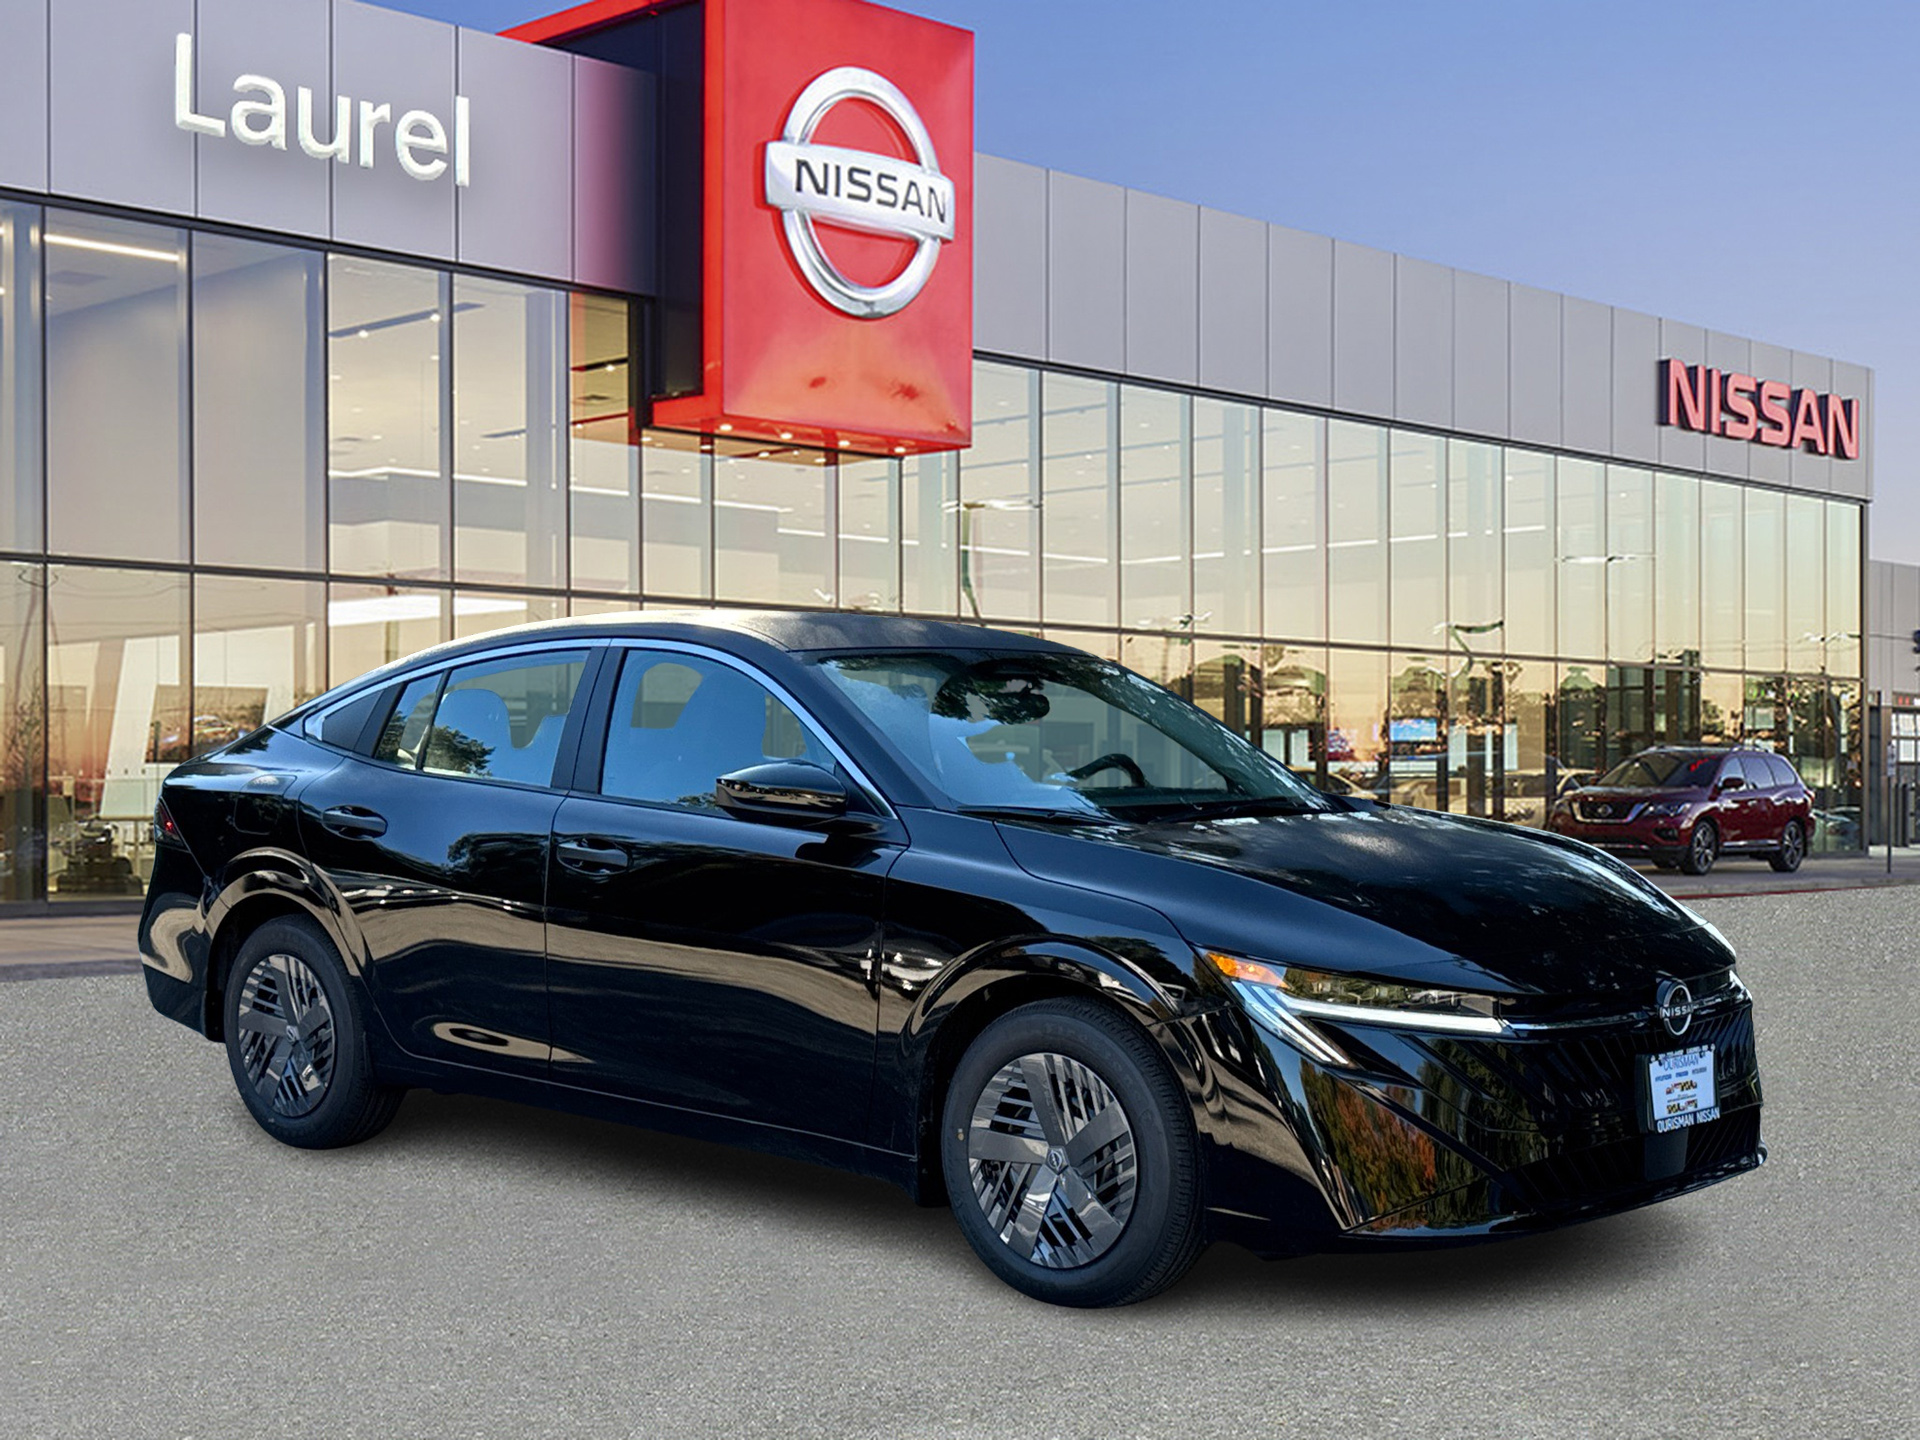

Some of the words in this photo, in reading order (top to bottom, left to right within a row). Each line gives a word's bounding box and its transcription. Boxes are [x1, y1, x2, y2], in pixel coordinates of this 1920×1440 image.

[174, 33, 470, 187] Laurel
[794, 158, 947, 224] NISSAN
[1658, 358, 1860, 460] NISSAN
[1657, 1113, 1695, 1133] OURISMAN
[1696, 1107, 1720, 1124] NISSAN
